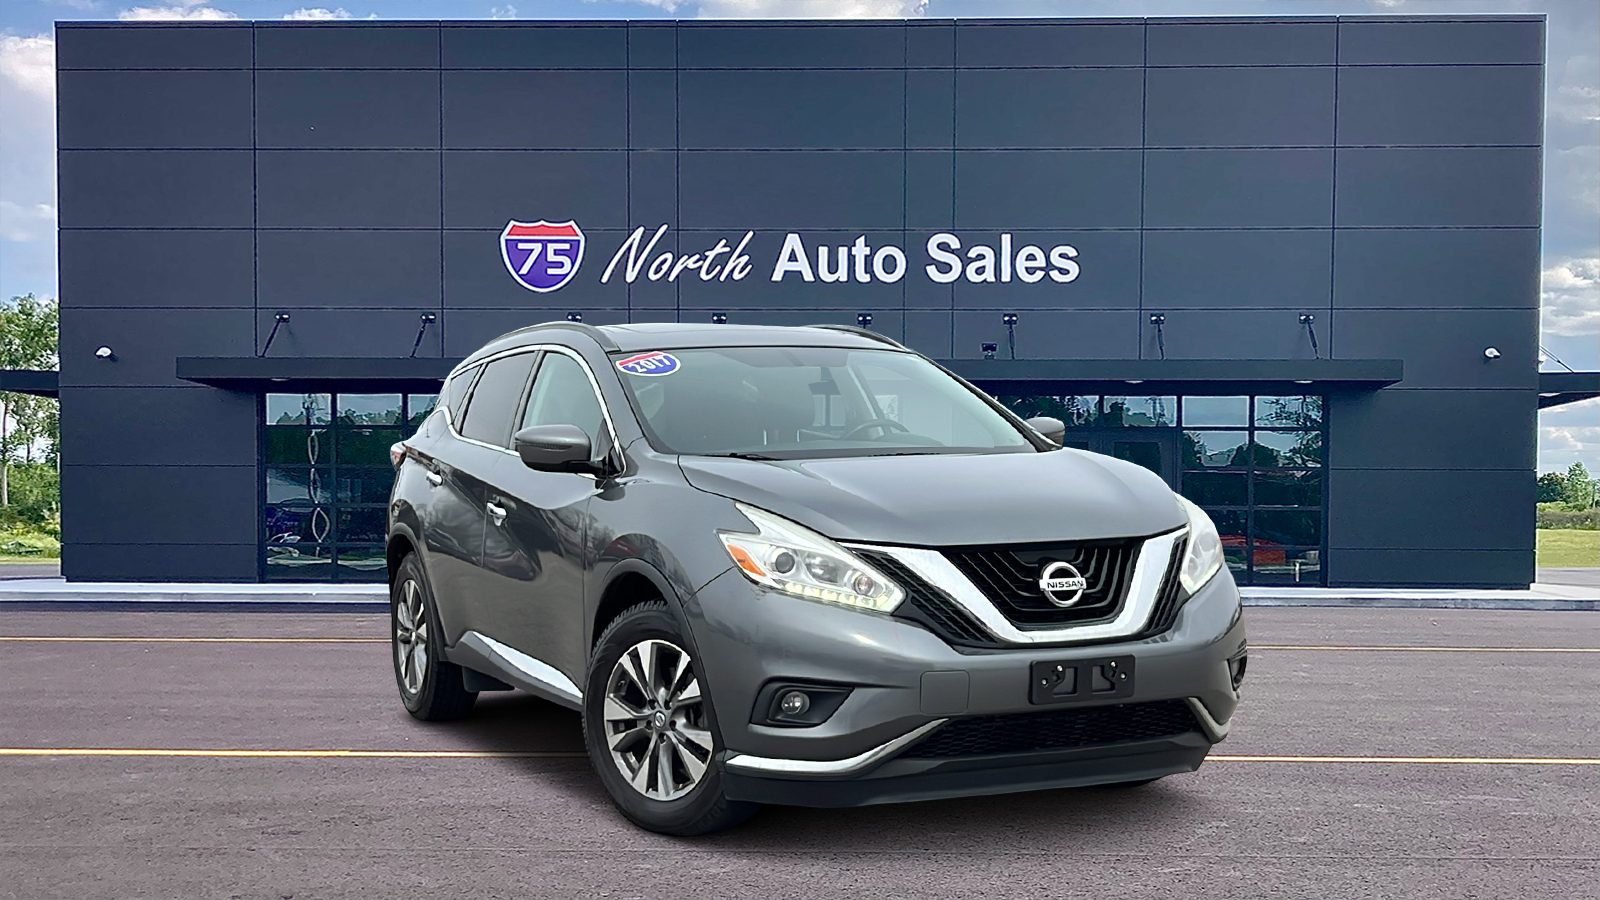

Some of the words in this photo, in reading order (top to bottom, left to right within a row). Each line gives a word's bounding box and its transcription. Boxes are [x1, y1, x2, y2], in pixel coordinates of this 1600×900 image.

[516, 242, 572, 275] 75
[600, 223, 754, 283] North
[771, 233, 905, 283] Auto
[925, 232, 1080, 283] Sales
[629, 357, 671, 372] 2017
[1047, 580, 1084, 589] NISSAN
